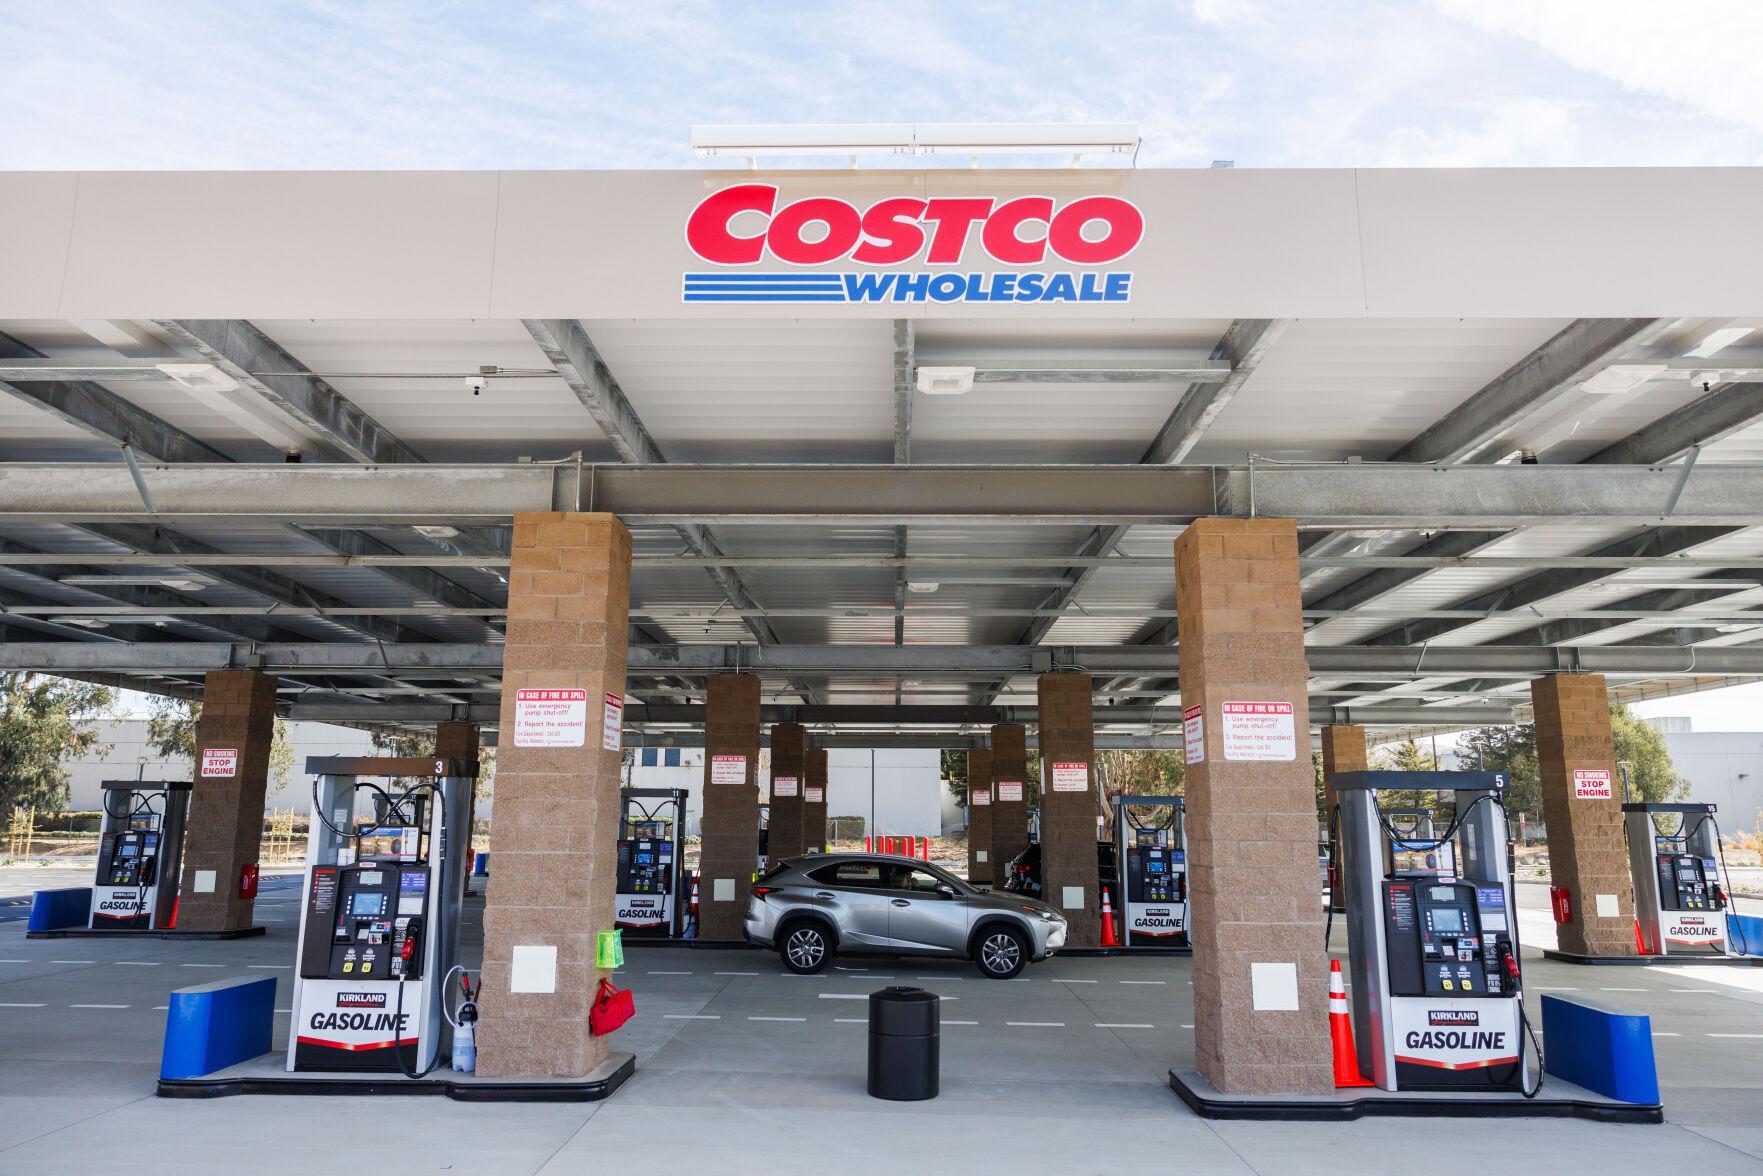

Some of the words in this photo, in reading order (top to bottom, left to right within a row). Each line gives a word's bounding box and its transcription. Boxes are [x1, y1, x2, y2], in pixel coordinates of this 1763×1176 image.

[687, 184, 1143, 265] COSTCO
[844, 273, 1131, 302] WHOLESALE
[518, 691, 525, 699] IN
[526, 691, 539, 699] CASE
[541, 691, 547, 699] OF
[549, 691, 560, 699] FIRE
[562, 691, 569, 699] OR
[570, 691, 584, 699] SPILL
[1224, 704, 1230, 713] IN
[1231, 704, 1245, 713] CASE
[1246, 704, 1253, 713] OF
[1255, 704, 1266, 713] FIRE
[1268, 704, 1275, 713] OR
[1276, 704, 1291, 713] SPILL
[203, 767, 235, 775] ENGINE
[435, 760, 443, 774] 3
[1495, 774, 1504, 788] 5
[1581, 780, 1604, 788] STOP
[1577, 789, 1610, 797] ENGINE
[100, 901, 148, 910] GASOLINE
[618, 909, 666, 919] GASOLINE
[1134, 918, 1183, 927] GASOLINE
[1670, 926, 1718, 936] GASOLINE
[339, 993, 385, 1002] KIRKLAND
[1430, 1011, 1477, 1020] KIRKLAND
[310, 1012, 410, 1031] GASOLINE
[1405, 1030, 1506, 1050] GASOLINE
